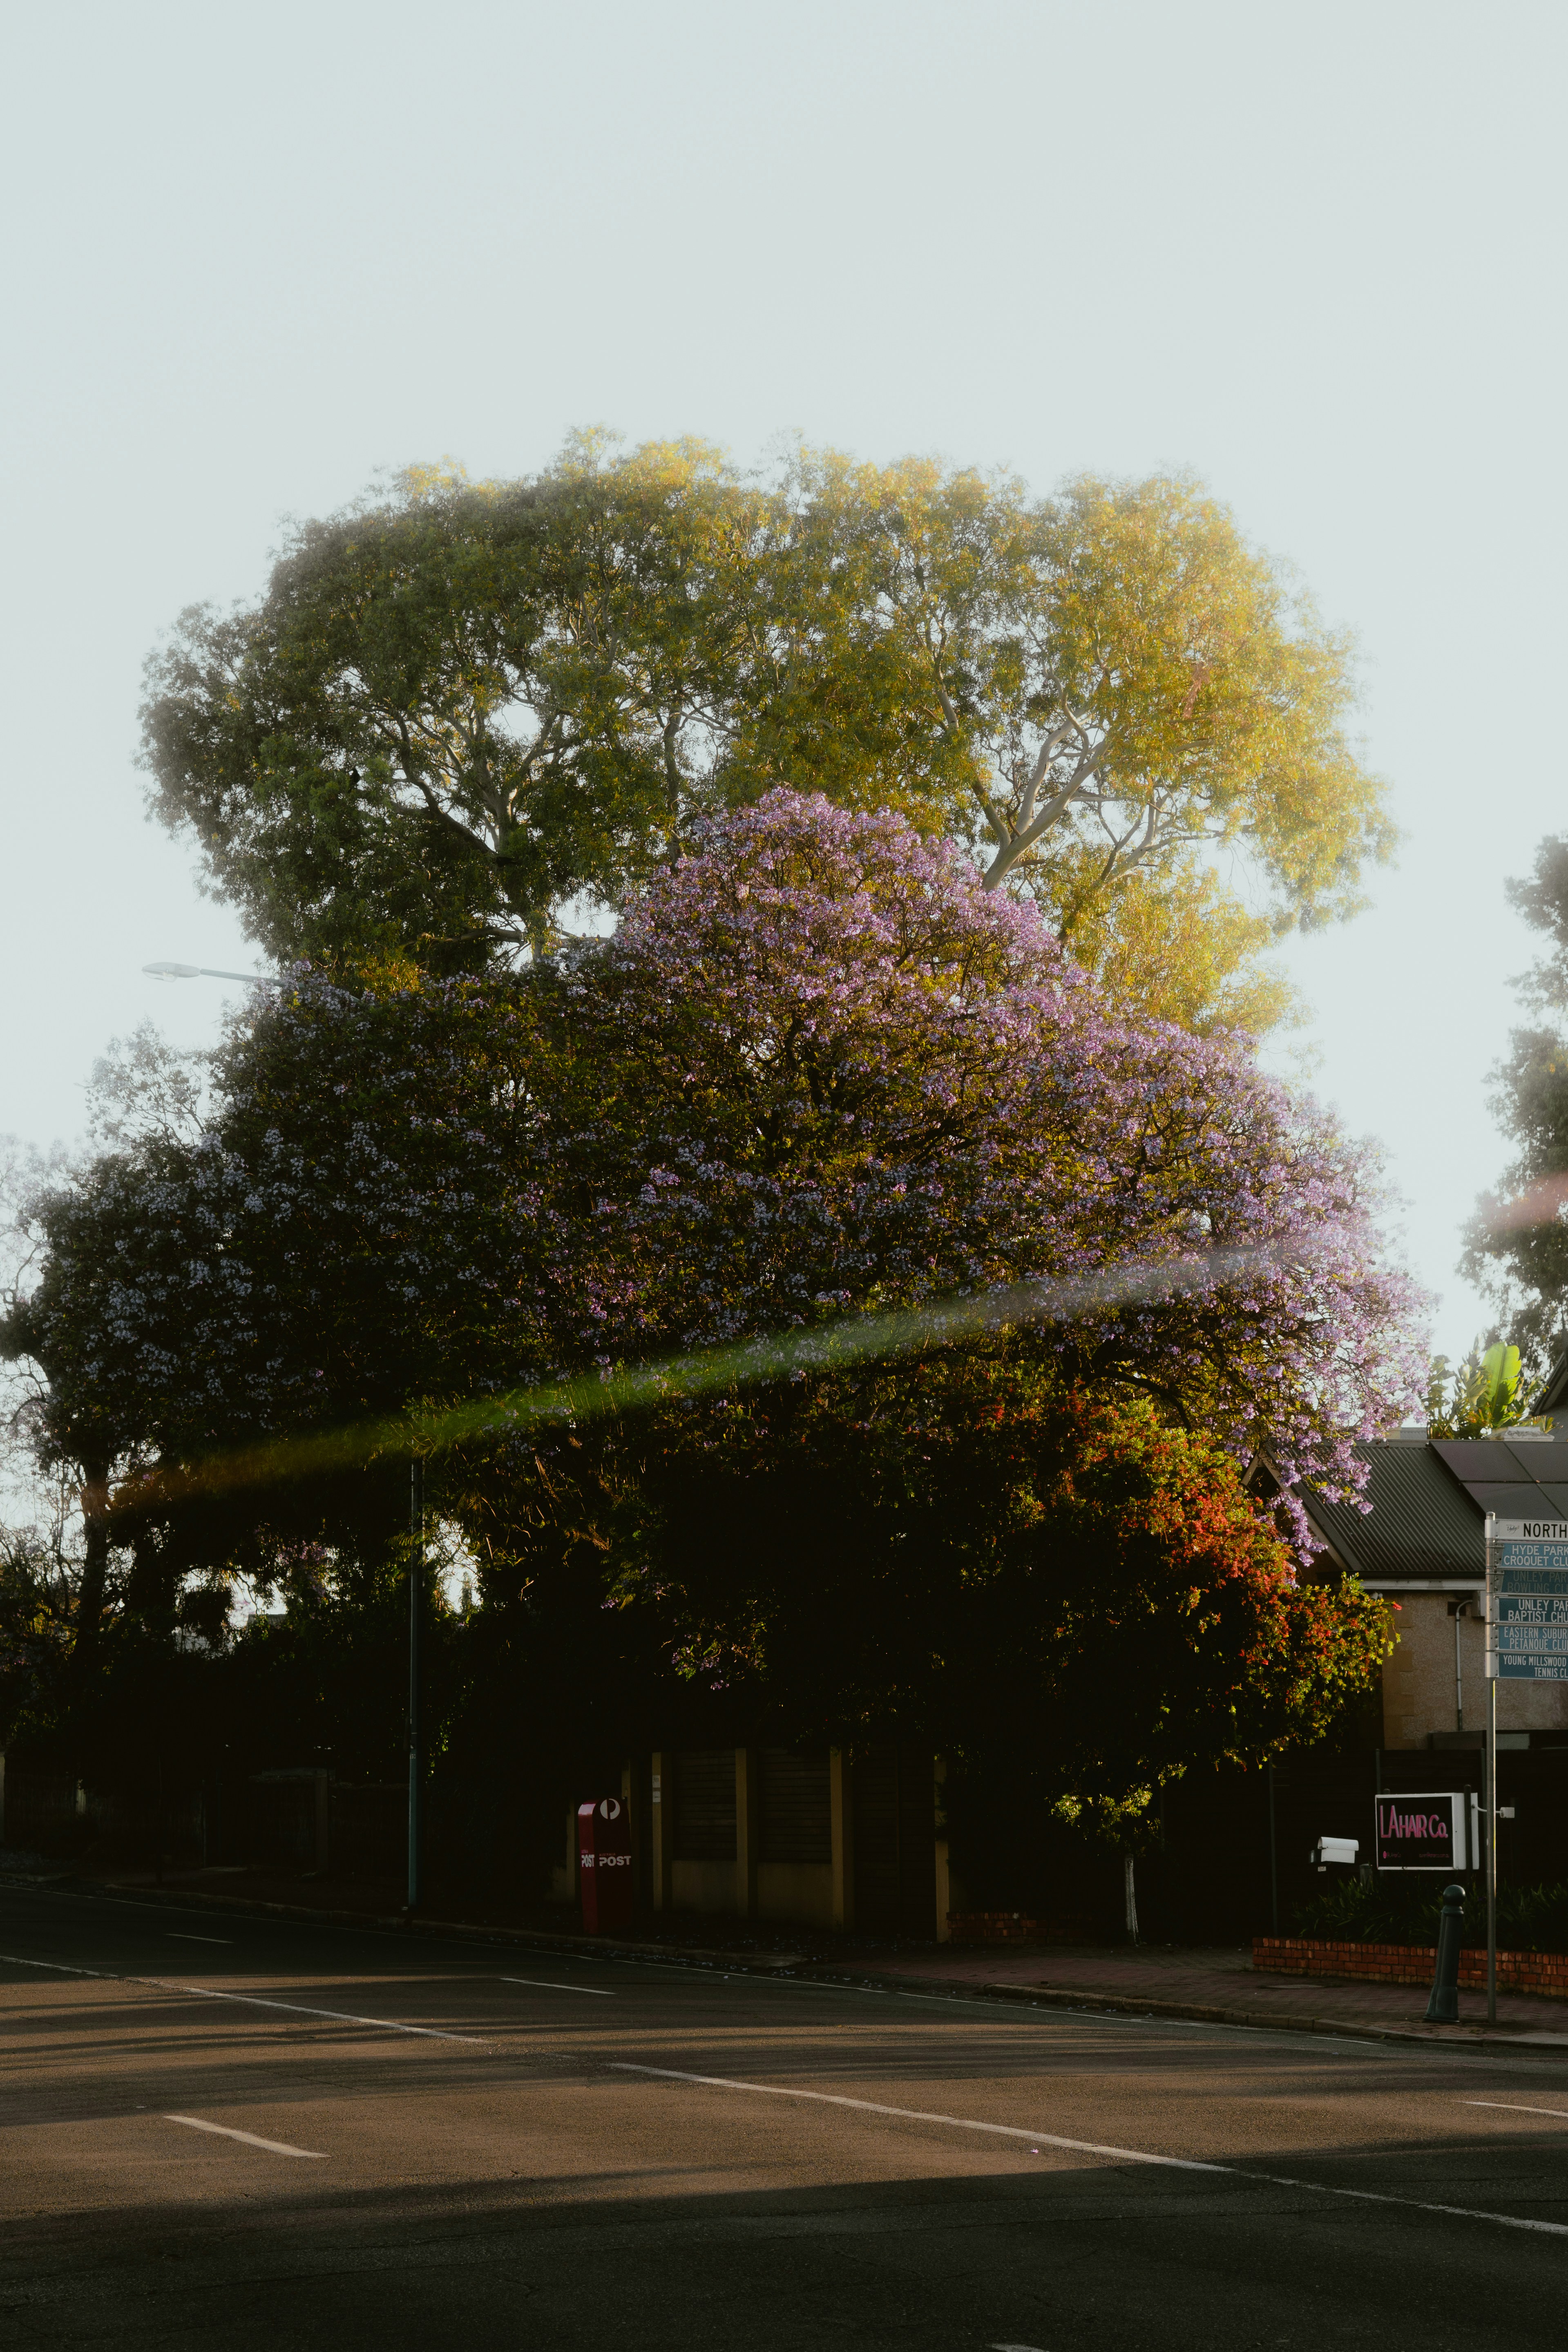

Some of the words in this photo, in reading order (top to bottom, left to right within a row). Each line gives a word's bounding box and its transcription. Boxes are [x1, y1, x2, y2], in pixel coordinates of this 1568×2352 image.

[1523, 1523, 1567, 1538] NORTH
[1512, 1545, 1540, 1555] HYDE
[1503, 1555, 1549, 1566] CROQUET
[1513, 1571, 1544, 1582] UNLEY
[1507, 1582, 1549, 1593] BOWLING
[1519, 1599, 1549, 1610] UNLEY
[1508, 1610, 1547, 1622] BAPTIST
[1504, 1626, 1539, 1638] EASTERN
[1542, 1628, 1568, 1639] SUBUR
[1510, 1638, 1548, 1650] PETANQUE
[1503, 1655, 1526, 1665] YOUNG
[1529, 1656, 1566, 1667] MILLSWOOD
[1534, 1667, 1558, 1677] TENNIS
[581, 1854, 595, 1867] POST
[599, 1856, 632, 1867] POST
